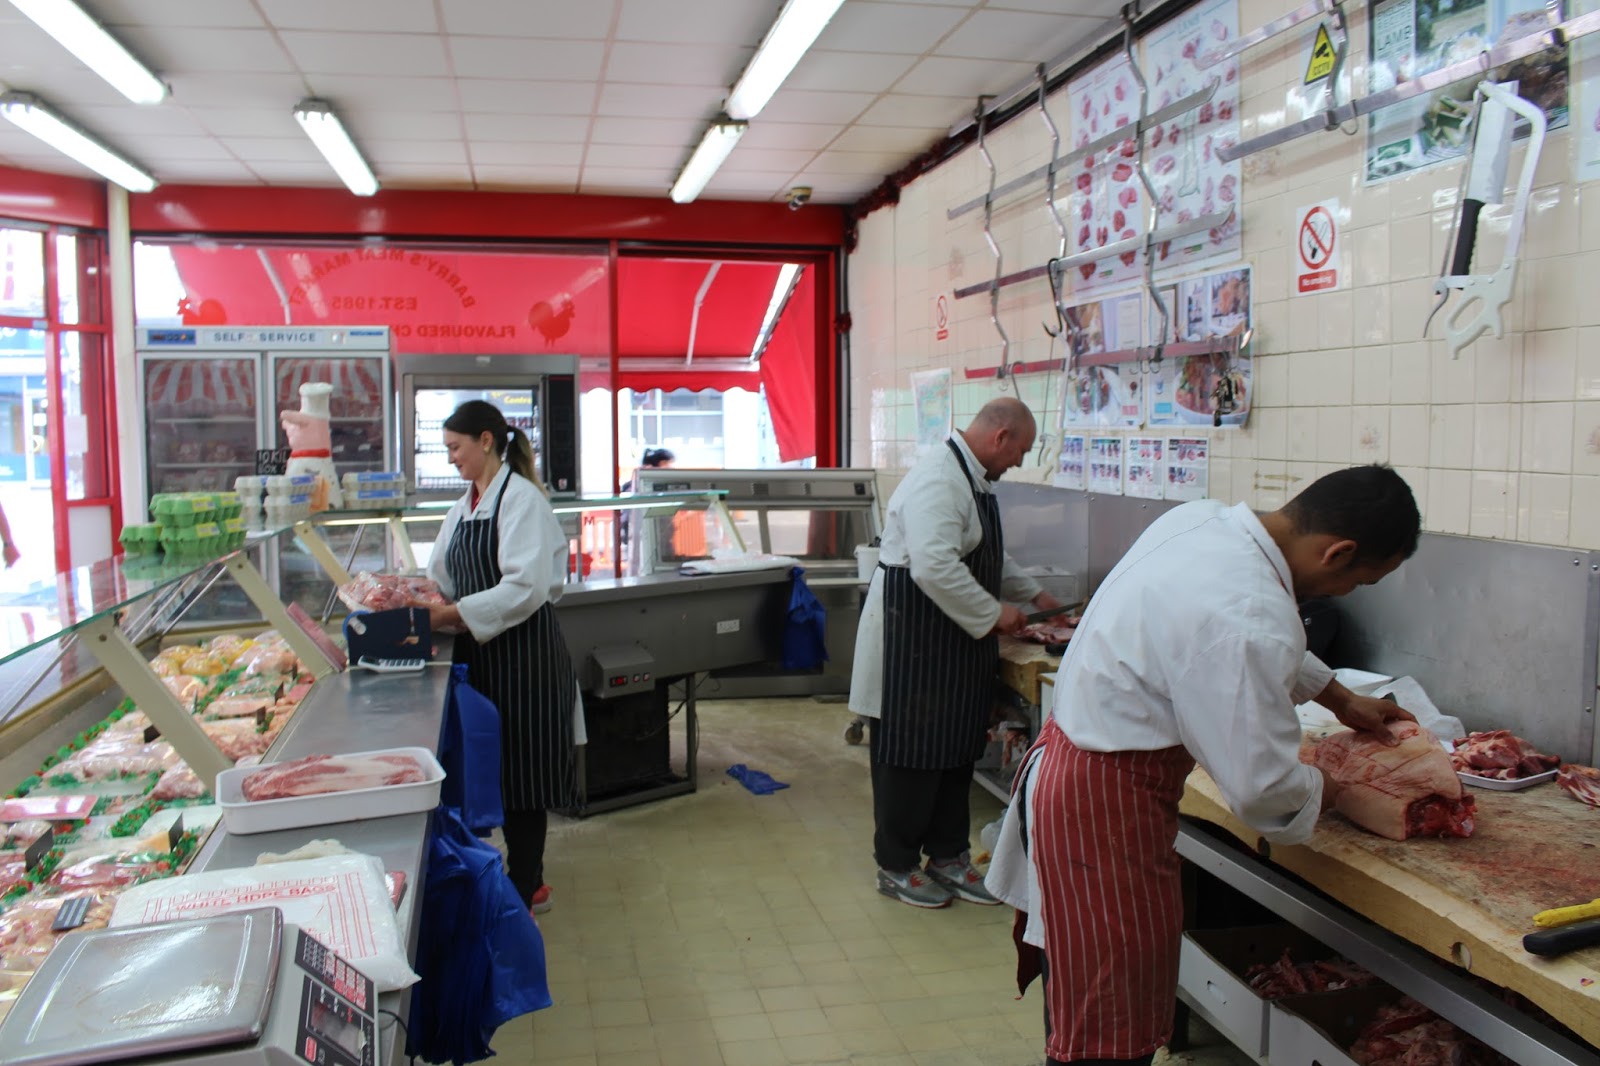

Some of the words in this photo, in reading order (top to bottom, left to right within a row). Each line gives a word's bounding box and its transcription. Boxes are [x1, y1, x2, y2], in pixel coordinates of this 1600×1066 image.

[214, 332, 244, 342] SELF
[259, 332, 316, 342] SERVICE
[175, 898, 231, 911] WHITE
[237, 891, 284, 904] HDPE
[289, 885, 337, 896] BAGS
